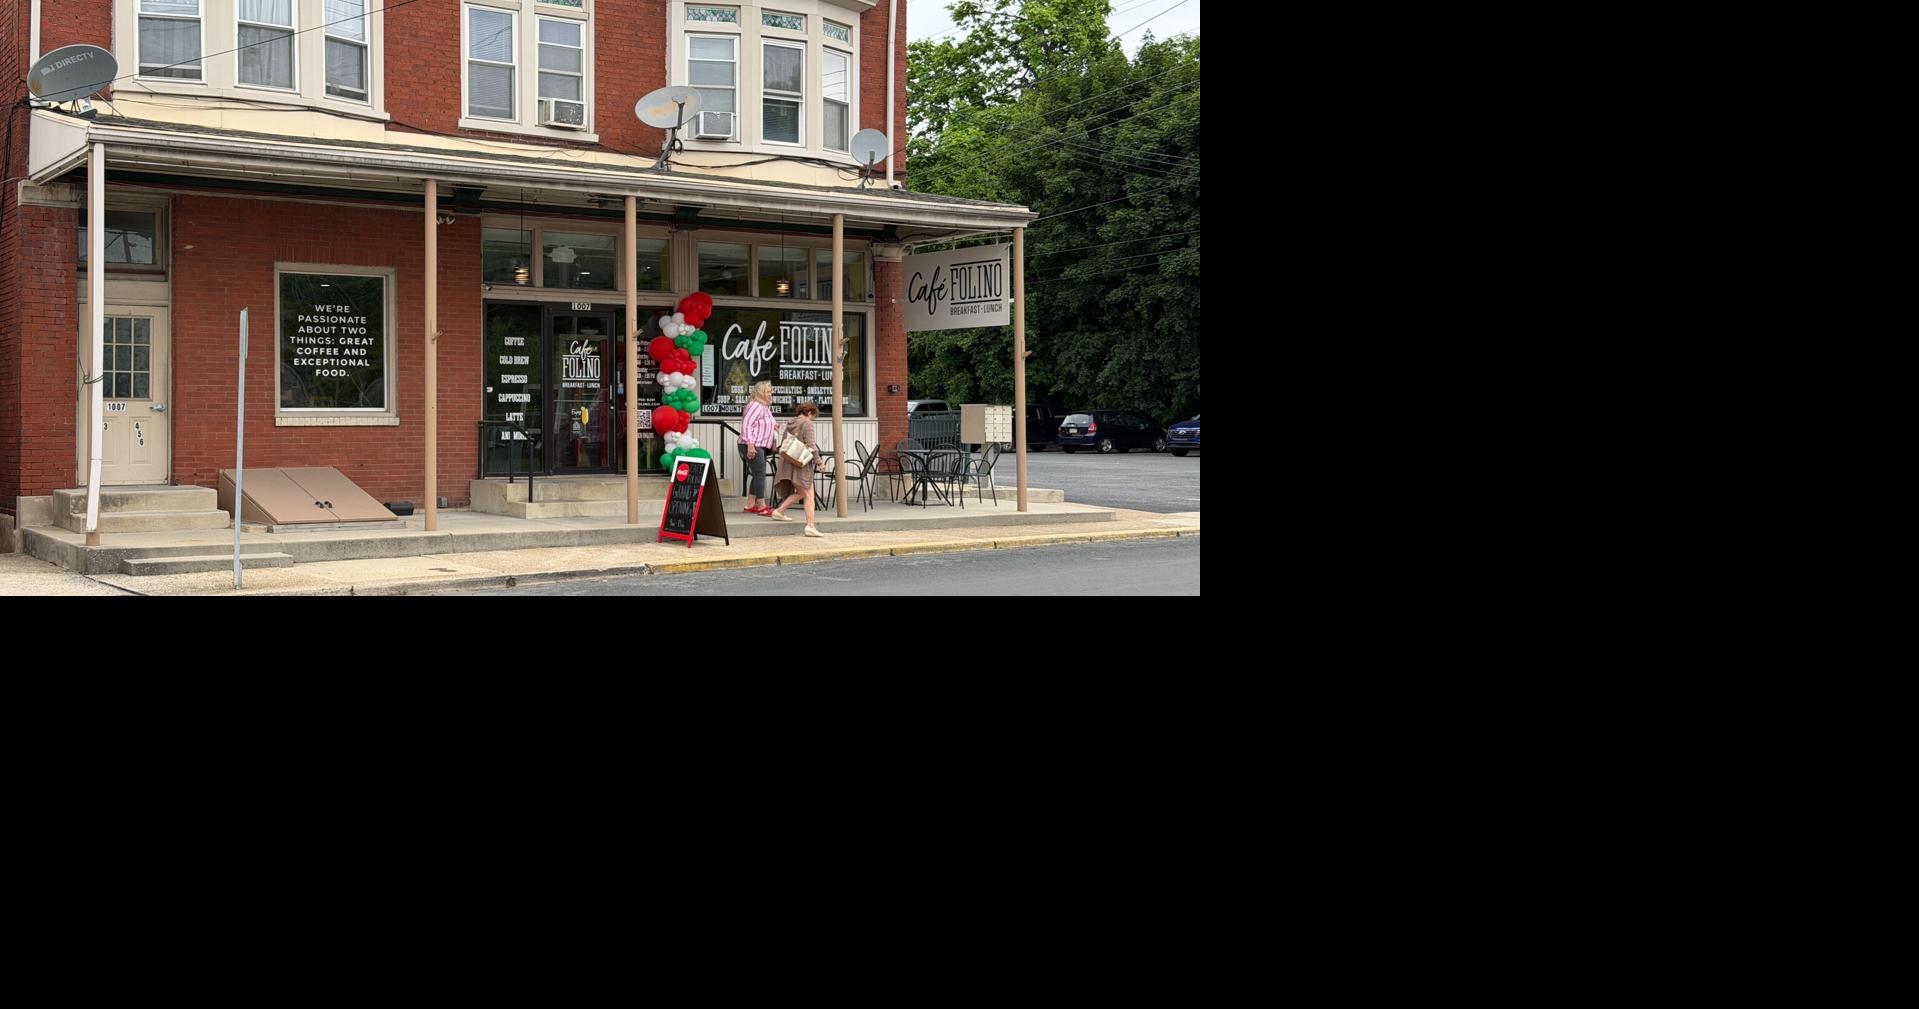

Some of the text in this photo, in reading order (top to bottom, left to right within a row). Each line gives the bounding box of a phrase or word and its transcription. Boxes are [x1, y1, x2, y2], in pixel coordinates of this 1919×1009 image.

[55, 51, 94, 70] DIRECTV
[908, 263, 1002, 315] Café FOLINO
[315, 305, 350, 313] WE'RE
[950, 304, 1002, 316] BREAKFAST LUNCH
[298, 315, 367, 324] PASSIONATE
[298, 326, 337, 334] ABOUT
[290, 336, 374, 345] THINGS: GREAT
[504, 336, 524, 346] COFFEE
[343, 348, 367, 356] AND
[722, 320, 777, 377] Café
[779, 325, 832, 364] FOLIN
[294, 358, 370, 367] EXCEPTIONAL
[499, 356, 529, 365] COLD BREW
[562, 339, 600, 378] Café FOLINO
[316, 369, 350, 377] FOOD.
[779, 370, 818, 380] BREAKFAST
[501, 375, 528, 383] ESPRESSO
[731, 385, 744, 394] EGGS
[498, 393, 531, 402] CAPPUCCINO
[717, 395, 730, 404] SOUP
[108, 403, 126, 411] 1007
[506, 412, 524, 421] LATTE
[104, 422, 108, 430] 3
